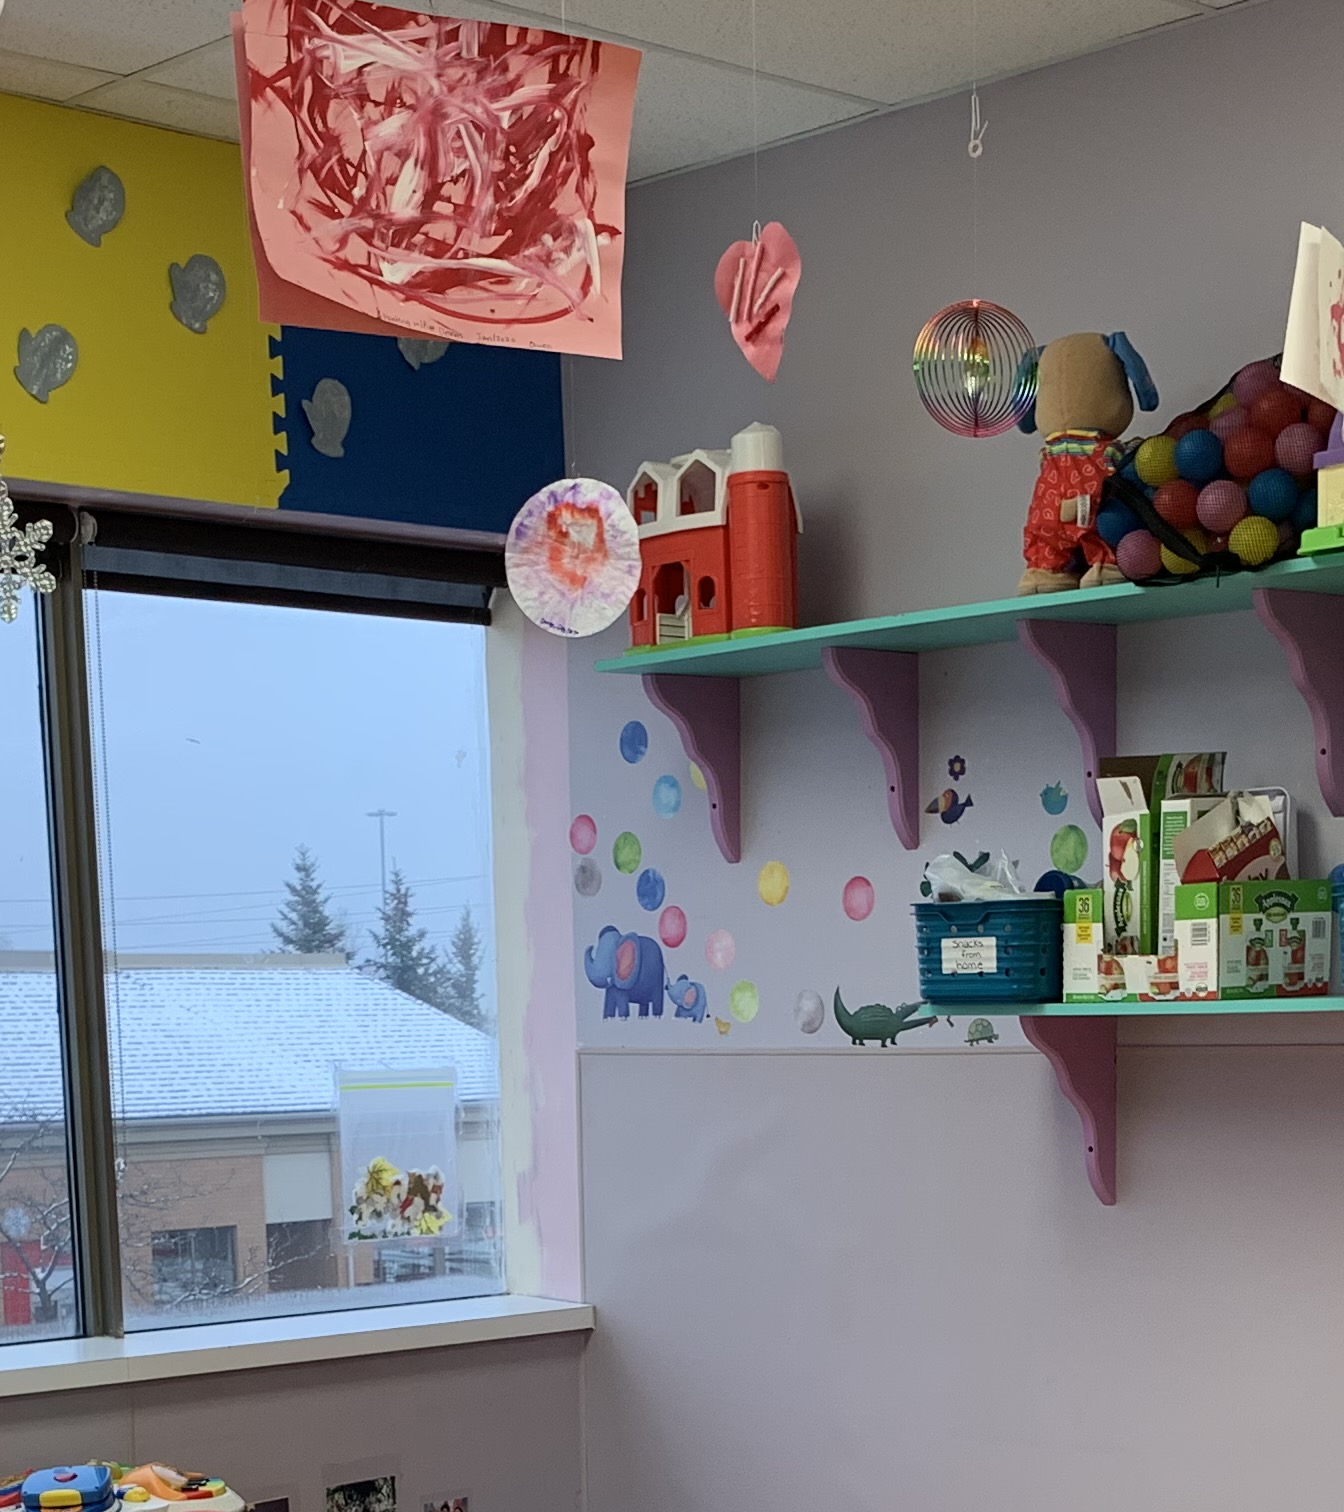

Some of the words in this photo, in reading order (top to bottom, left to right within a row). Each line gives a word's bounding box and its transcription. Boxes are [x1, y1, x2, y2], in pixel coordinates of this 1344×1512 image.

[1078, 897, 1090, 913] 36
[952, 940, 984, 949] Snacks
[961, 949, 982, 958] from
[955, 960, 983, 970] home
